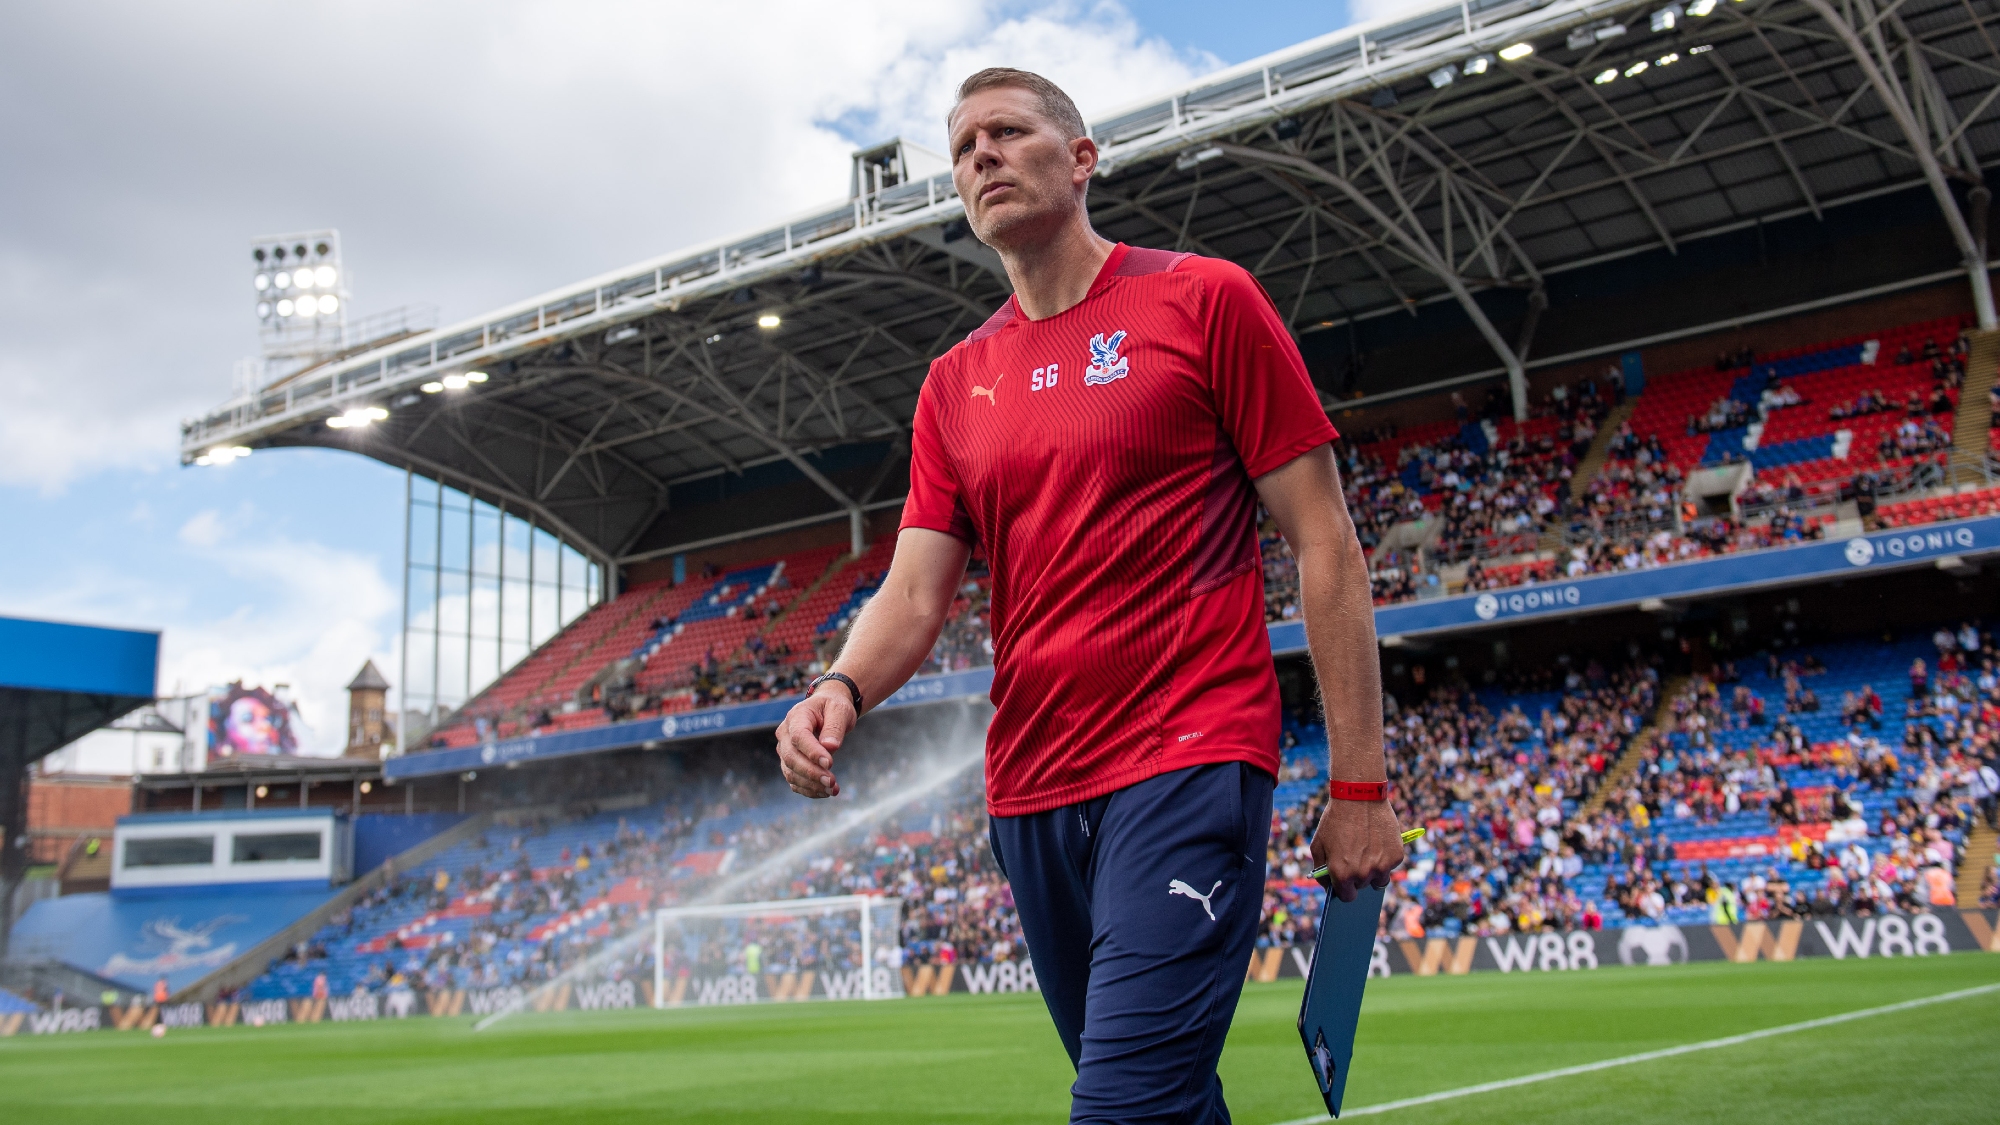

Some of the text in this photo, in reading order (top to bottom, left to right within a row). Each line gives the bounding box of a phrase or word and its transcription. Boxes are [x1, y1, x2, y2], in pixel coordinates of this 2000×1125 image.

[1031, 363, 1059, 391] SG
[1875, 527, 1975, 558] IQONIQ
[1501, 586, 1580, 613] IQONIQ
[1487, 930, 1599, 973] W88
[1815, 914, 1949, 959] W88
[692, 974, 759, 1006] W88
[961, 958, 1041, 995] W88
